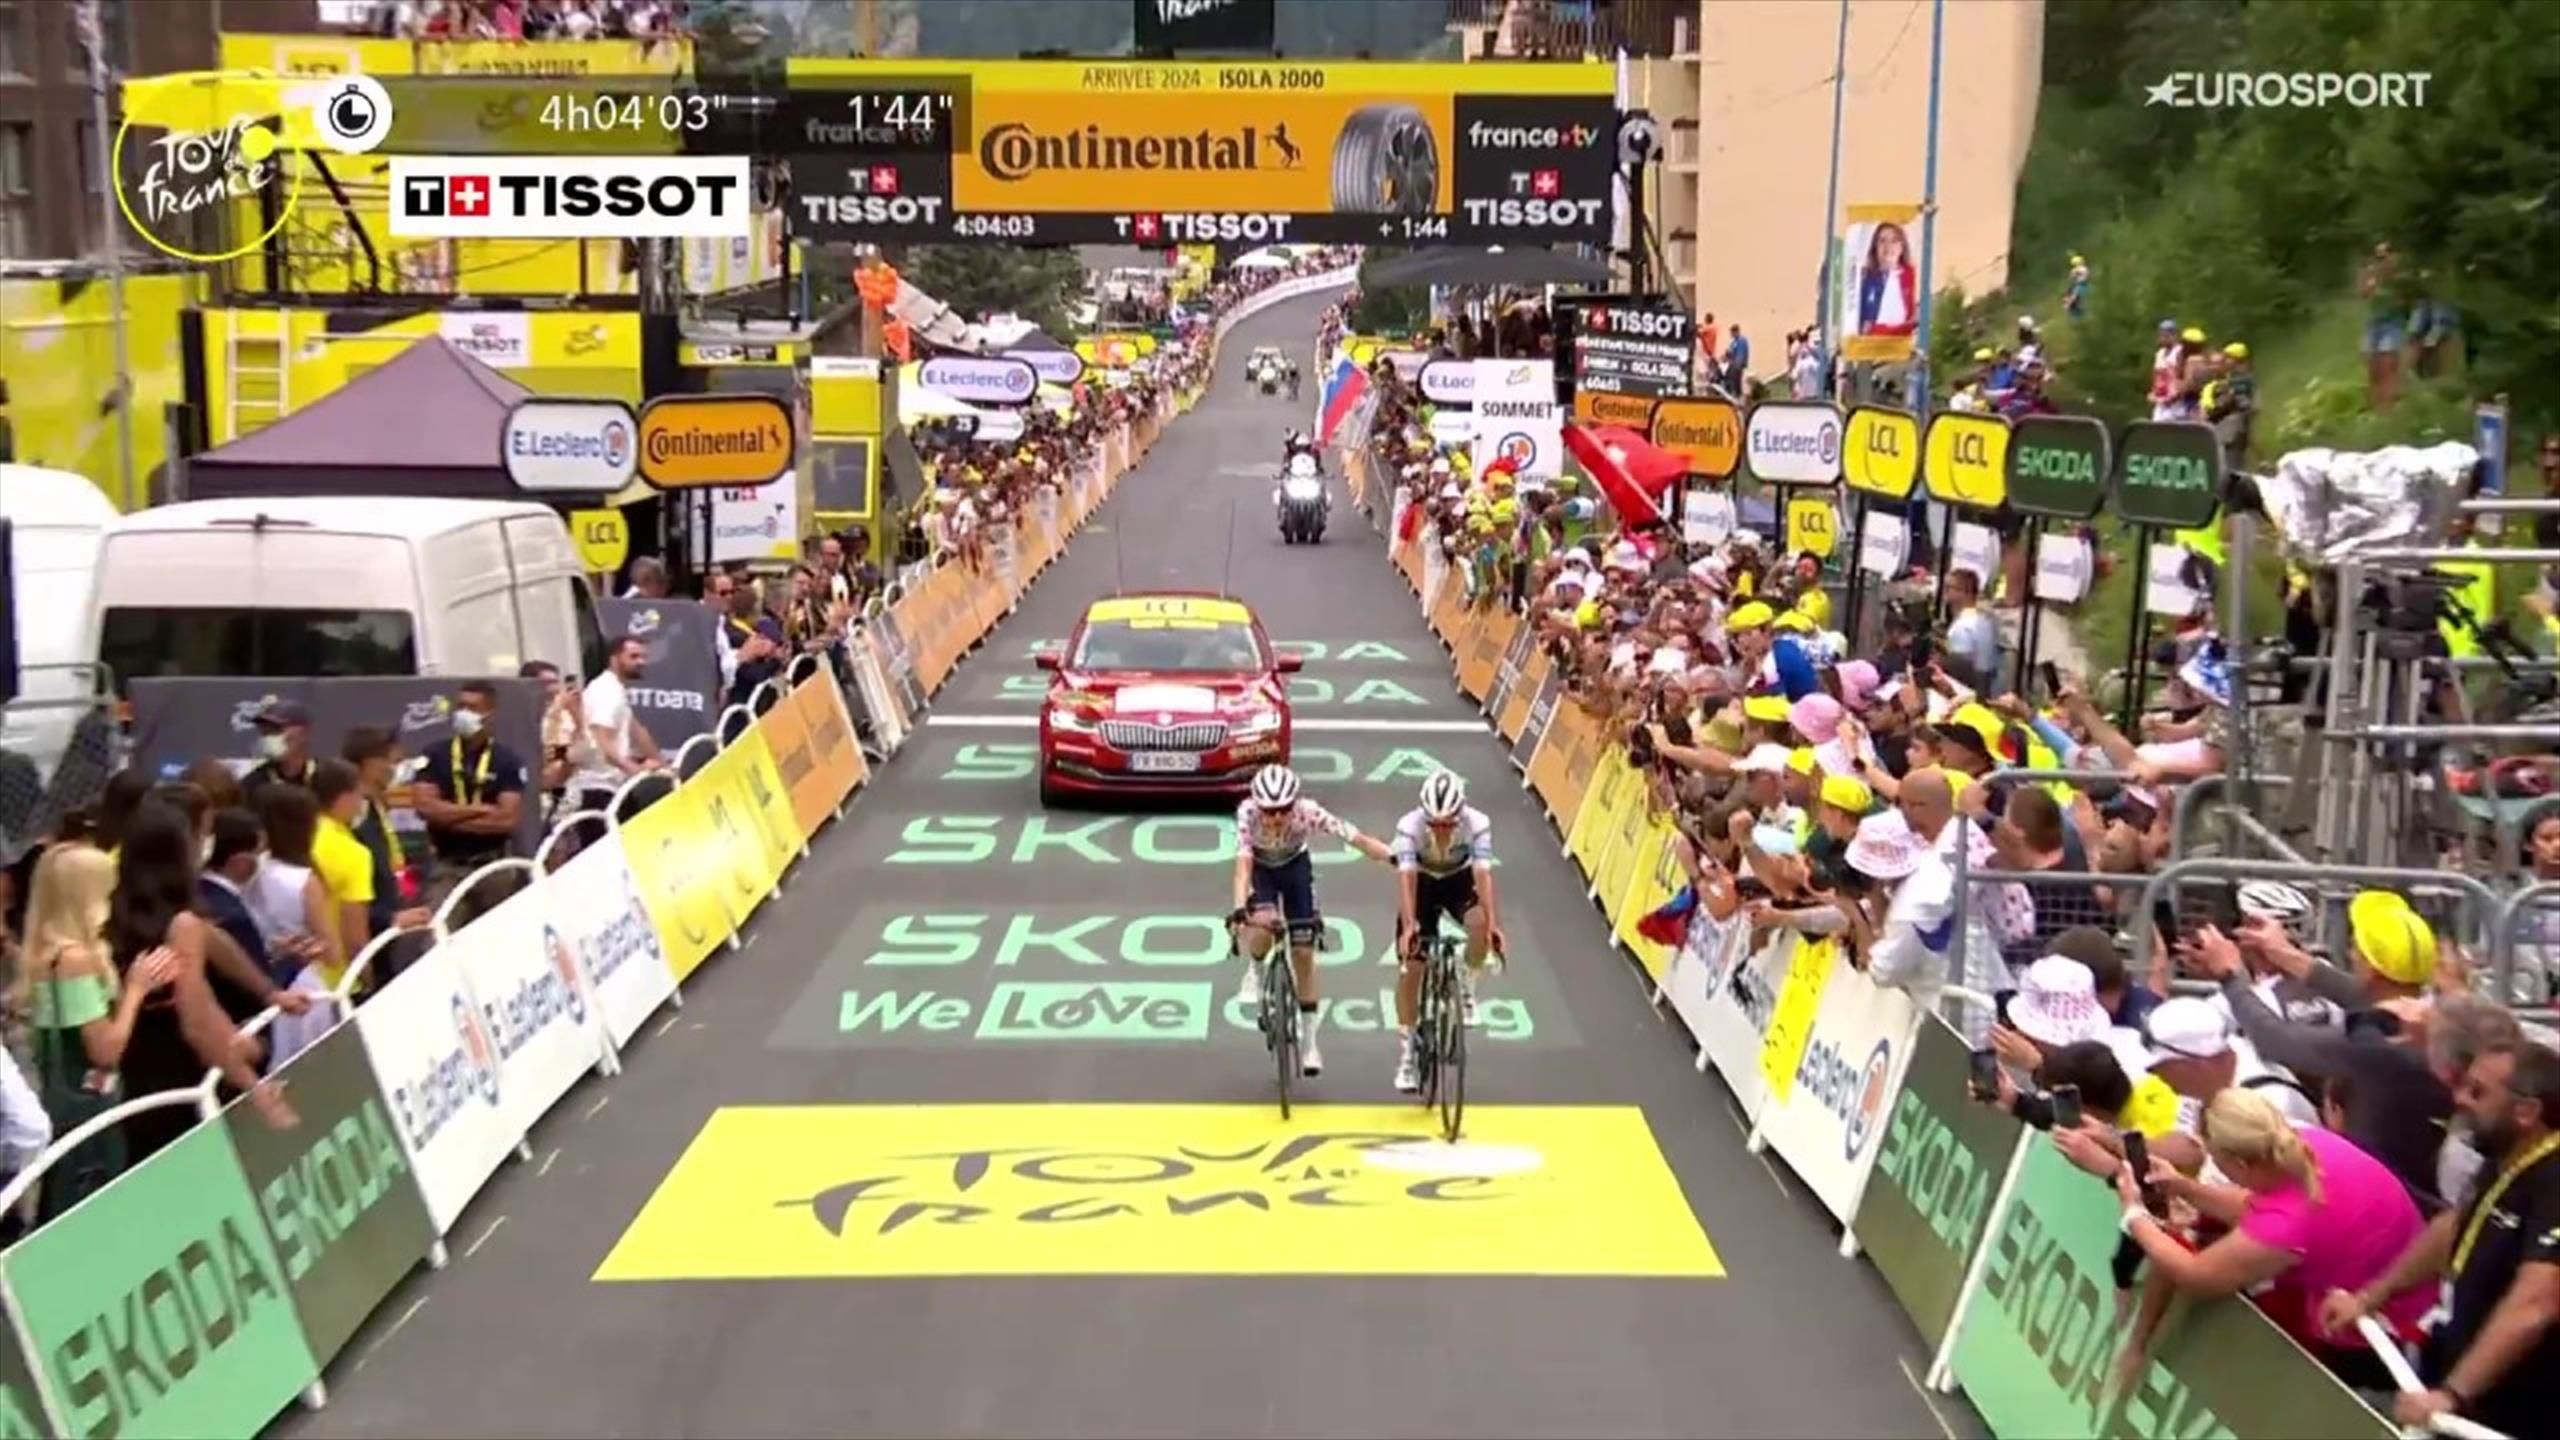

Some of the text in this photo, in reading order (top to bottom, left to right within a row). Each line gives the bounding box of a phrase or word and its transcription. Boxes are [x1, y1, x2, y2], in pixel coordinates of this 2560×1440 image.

[1161, 68, 1201, 88] 2024
[1219, 69, 1273, 89] ISOLA
[1279, 69, 1325, 89] 2000
[980, 122, 1258, 181] Continental
[801, 195, 942, 225] TISSOT
[1463, 199, 1604, 227] TISSOT
[953, 216, 1035, 236] 4:04:03
[1162, 214, 1293, 240] TISSOT
[1608, 308, 1687, 339] TISSOT
[1481, 401, 1553, 420] SOMMET
[647, 426, 765, 465] Continental
[1752, 427, 1817, 457] E.Leclerc
[1869, 421, 1900, 457] LCL
[1953, 430, 1988, 468] LCL
[584, 520, 621, 545] LCL
[1800, 511, 1828, 535] LCL
[839, 990, 971, 1032] We
